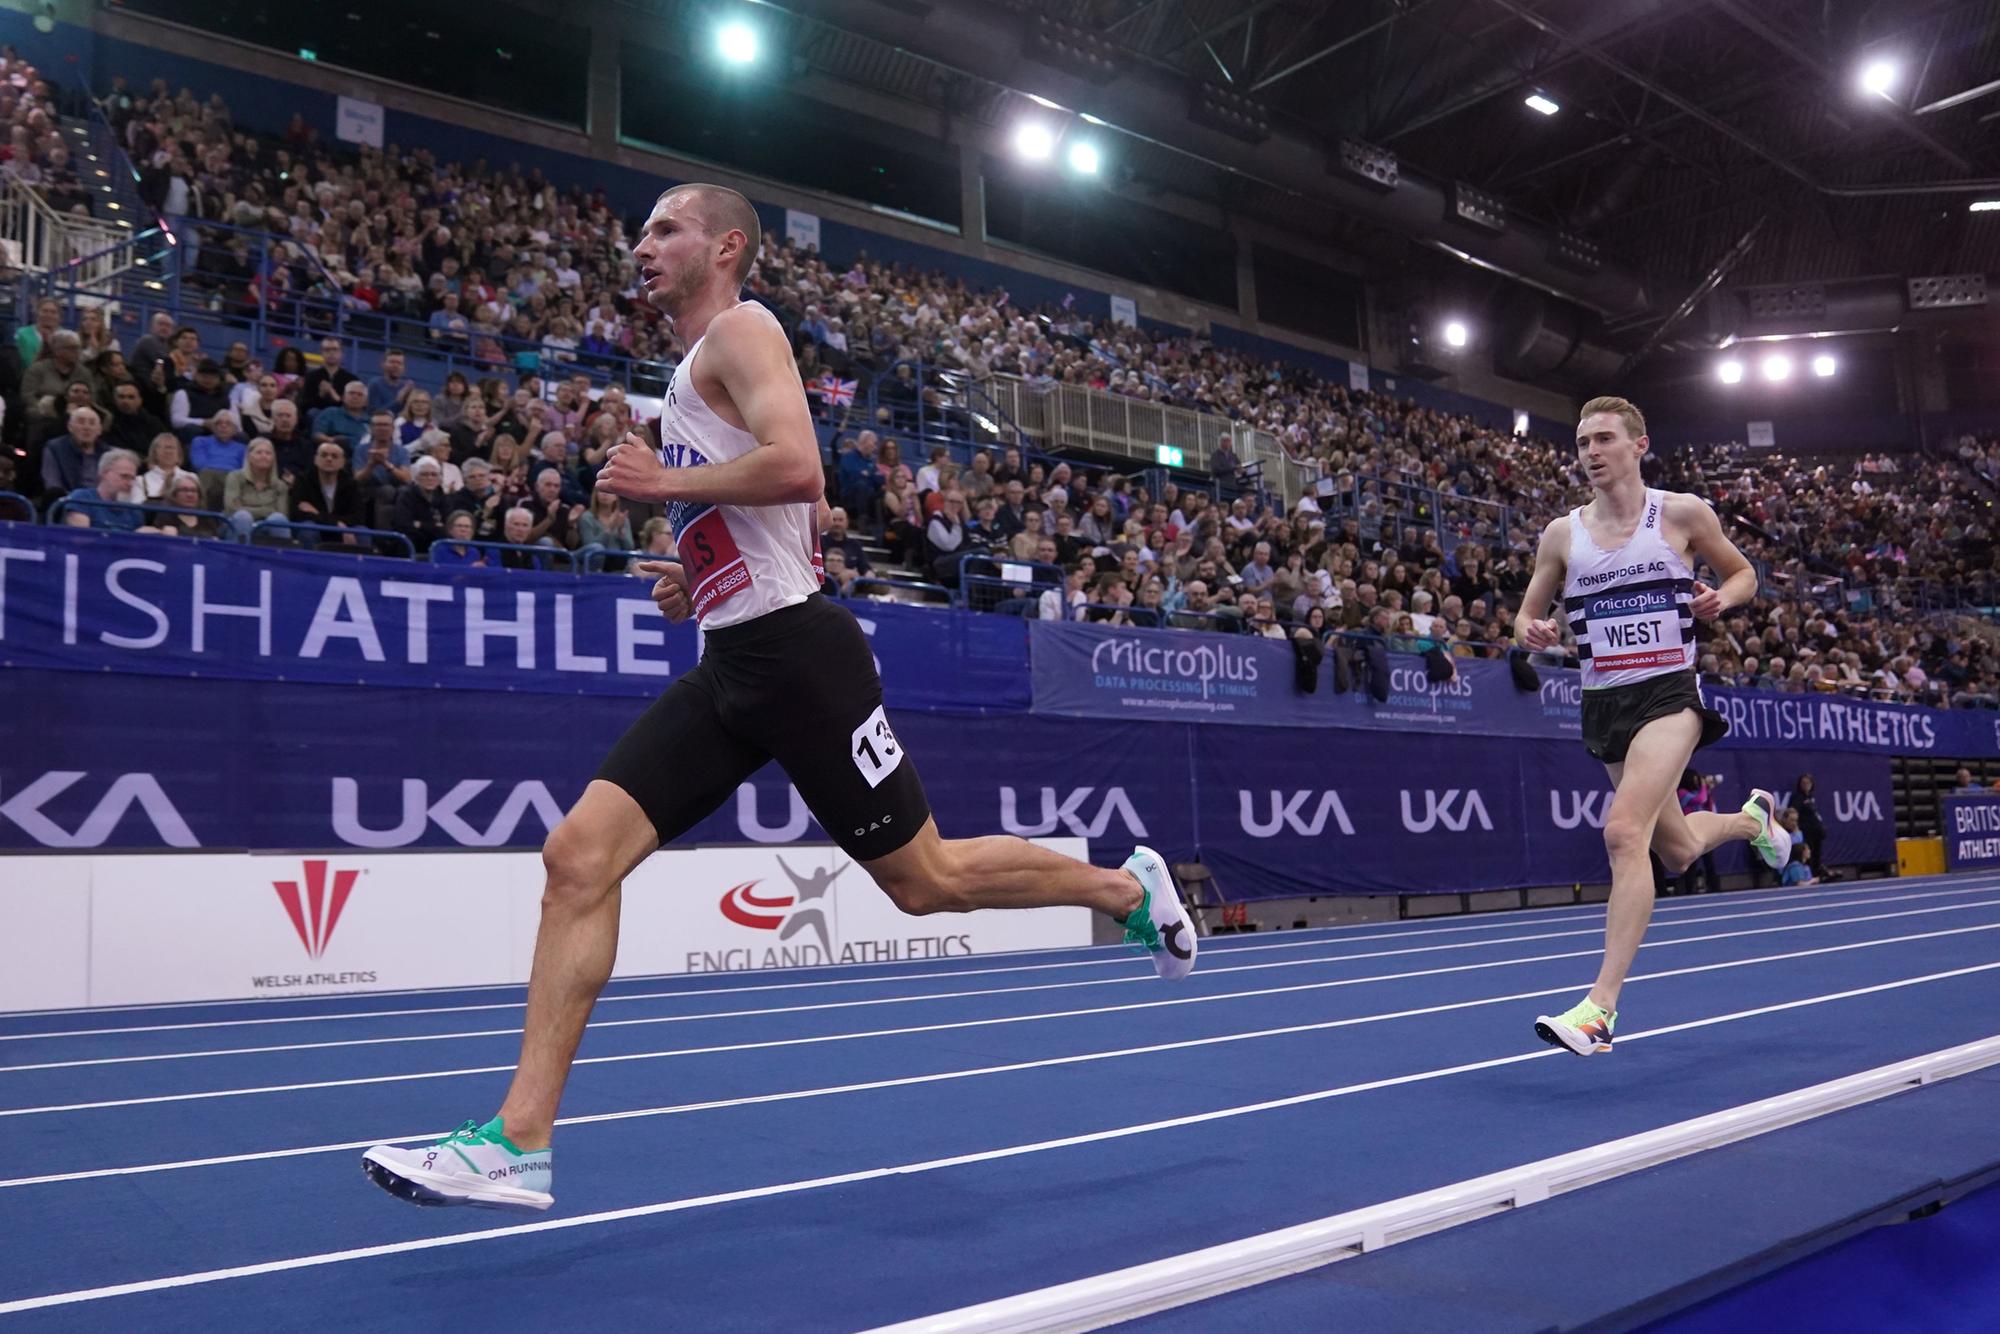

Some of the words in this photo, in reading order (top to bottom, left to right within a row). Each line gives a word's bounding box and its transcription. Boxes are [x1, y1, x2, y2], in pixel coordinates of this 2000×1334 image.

[1645, 502, 1657, 529] soar
[717, 570, 748, 592] INDOOR
[1577, 563, 1645, 587] TONBRIDGE
[1648, 561, 1665, 573] AC
[1604, 620, 1662, 648] WEST
[1595, 656, 1655, 668] BIRMINGHAM
[1095, 675, 1127, 689] DATA
[1130, 678, 1202, 694] PROCESSING
[1219, 685, 1258, 697] TIMING
[1714, 696, 1816, 739] BRITISH
[1819, 703, 1935, 749] ATHLETICS
[857, 720, 896, 769] 13
[332, 777, 567, 848] UKA
[1000, 786, 1149, 838] UKA
[1239, 790, 1355, 838] UKA
[1401, 790, 1494, 833] UKA
[1834, 790, 1884, 822] UKA
[854, 815, 892, 837] OAC
[686, 944, 821, 973] ENGLAND
[839, 935, 972, 963] ATHLETICS
[252, 976, 302, 988] WELSH
[305, 971, 377, 985] ATHLETICS
[488, 1168, 507, 1181] ON
